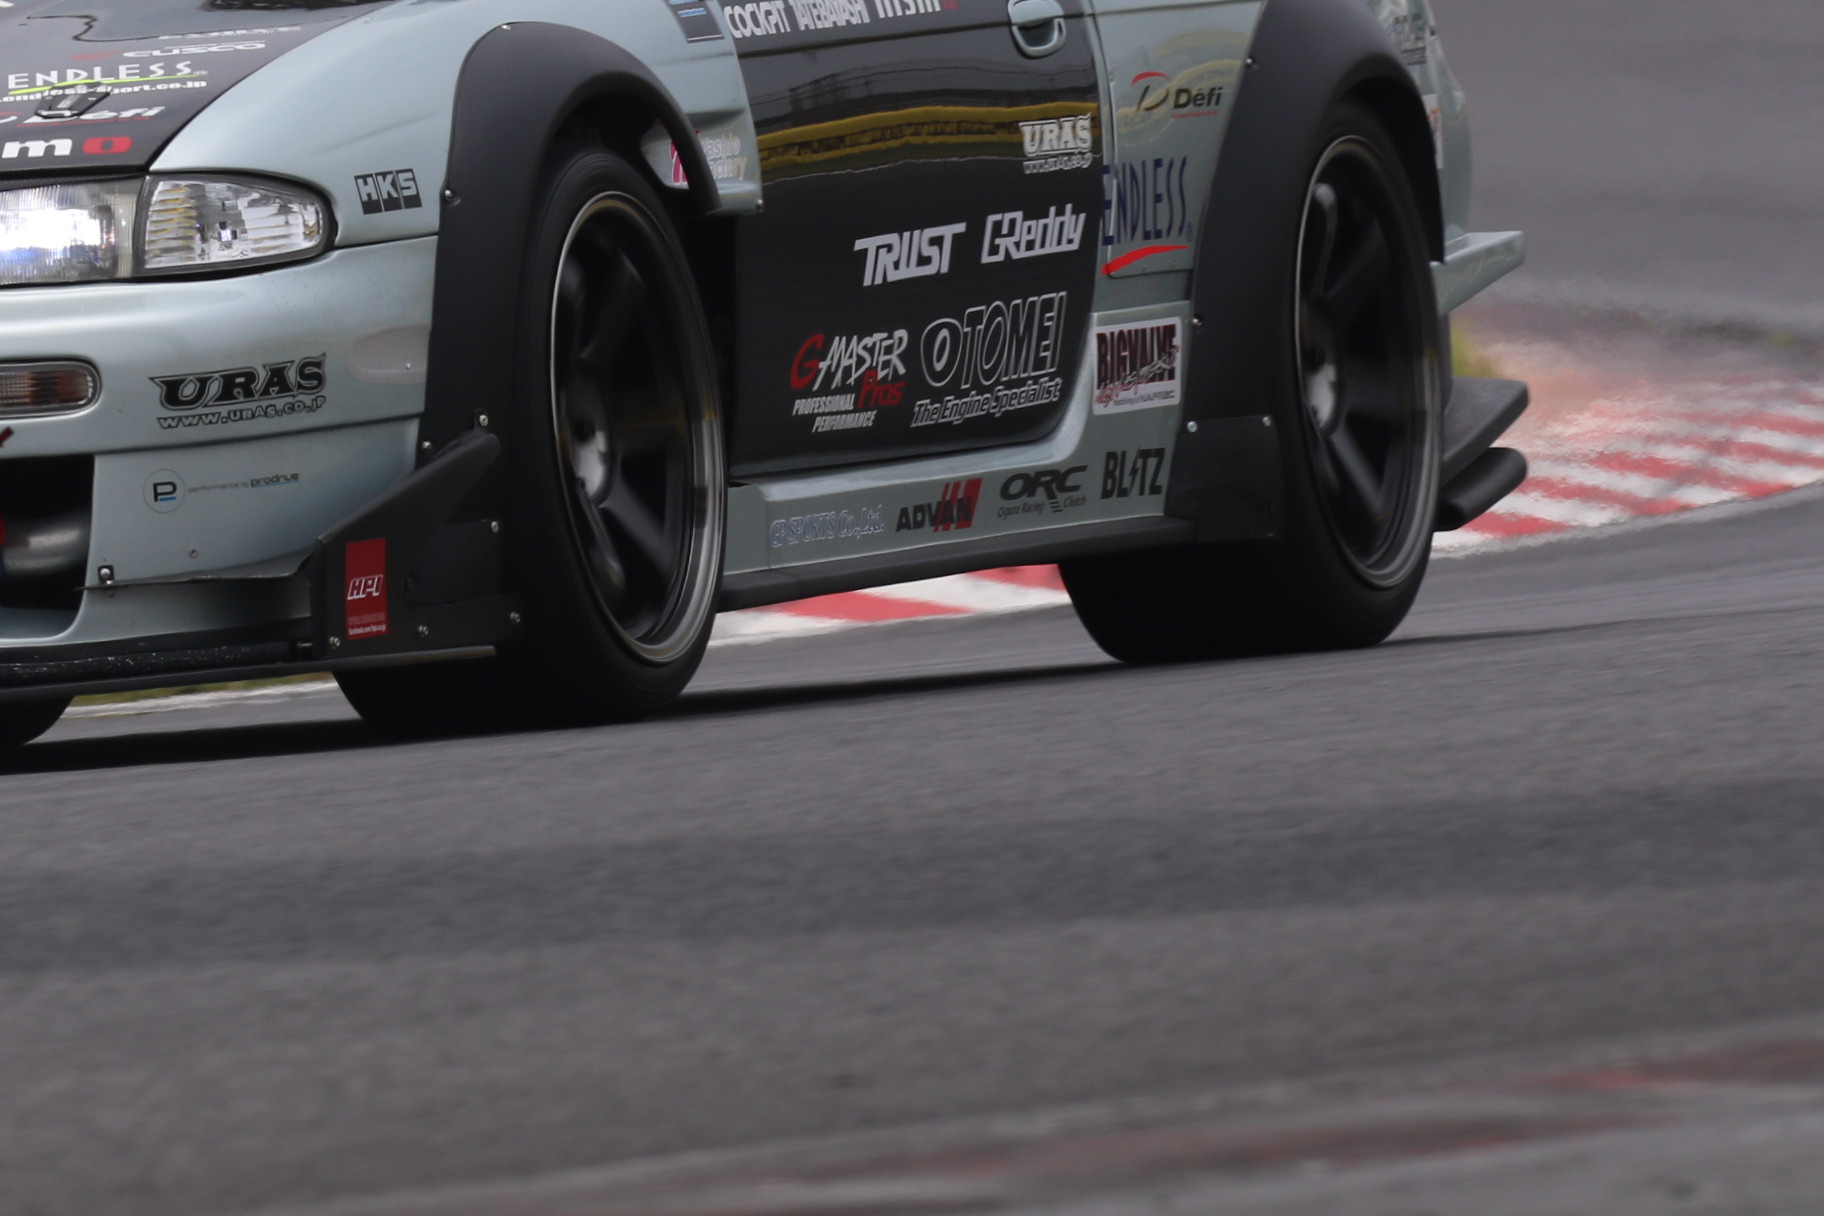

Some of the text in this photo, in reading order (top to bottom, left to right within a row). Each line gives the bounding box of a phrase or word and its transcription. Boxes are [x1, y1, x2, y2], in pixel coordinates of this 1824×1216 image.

[723, 0, 791, 39] COCKPIT
[7, 61, 193, 90] ENDLESS
[1018, 112, 1093, 157] URAS
[355, 170, 419, 206] HKS
[1101, 154, 1188, 247] ENDLESS
[853, 222, 967, 286] TRUST
[148, 351, 327, 411] URAS
[792, 394, 856, 417] PROFESSIONAL
[812, 410, 877, 433] PERFORMANCE
[910, 377, 1063, 428] The Engine Specialist
[999, 464, 1089, 501] ORC
[895, 495, 974, 533] ADVAN
